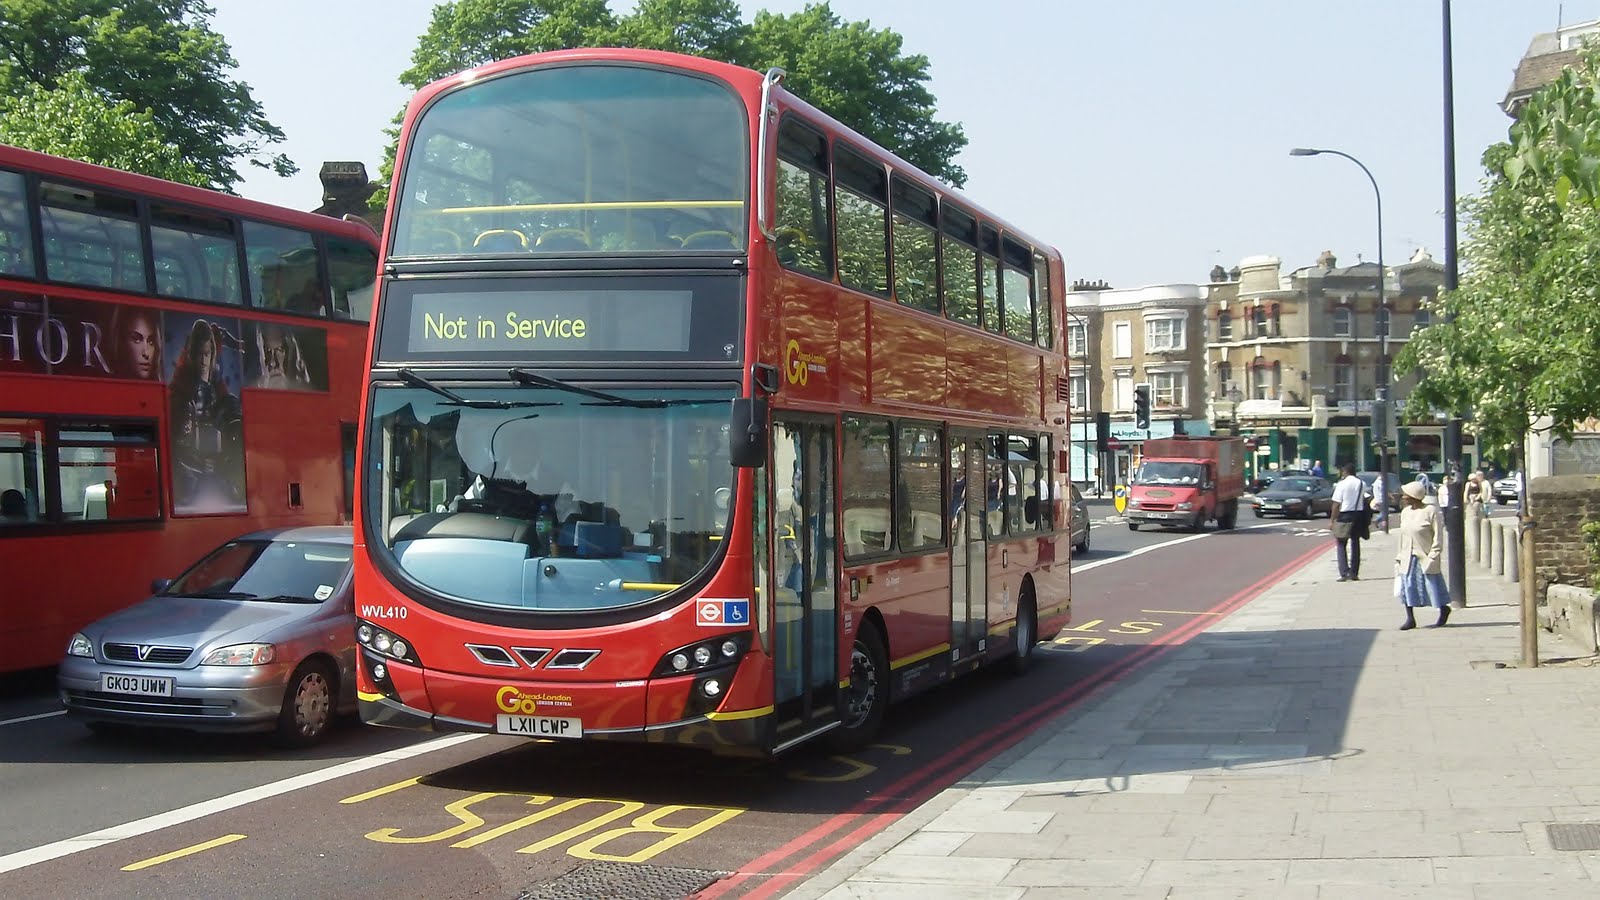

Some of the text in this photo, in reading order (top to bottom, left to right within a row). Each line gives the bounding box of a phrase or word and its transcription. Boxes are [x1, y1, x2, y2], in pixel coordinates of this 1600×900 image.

[424, 311, 586, 340] Not in Service
[361, 604, 408, 619] WVL410
[107, 676, 166, 693] GK03 UWW
[496, 686, 536, 714] Go
[509, 717, 569, 734] LX11 CWP
[364, 791, 748, 863] BUS
